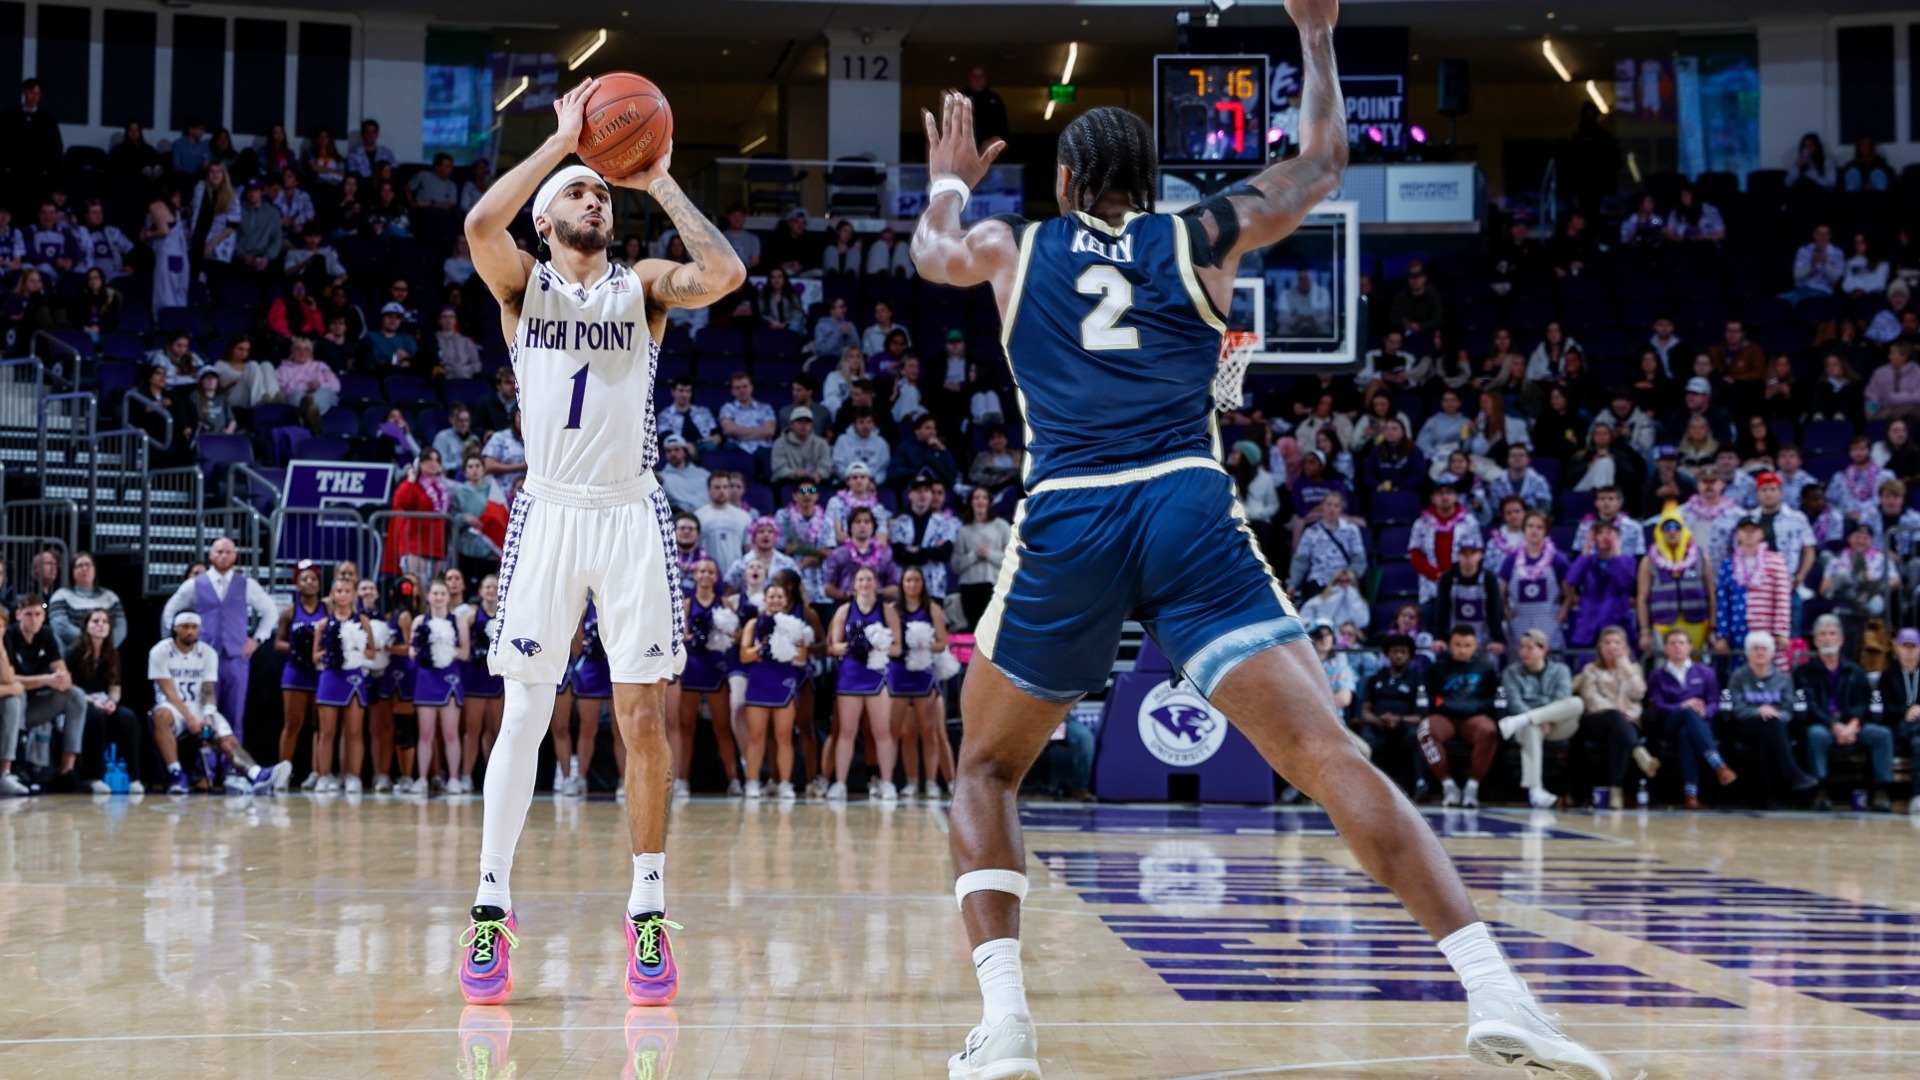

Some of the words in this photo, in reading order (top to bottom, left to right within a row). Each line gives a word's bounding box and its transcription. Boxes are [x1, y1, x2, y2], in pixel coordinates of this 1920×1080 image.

[843, 55, 889, 80] 112
[1188, 68, 1255, 98] 7:16
[1346, 96, 1404, 120] POINT
[584, 102, 643, 154] SPALDING
[1215, 101, 1245, 153] 7
[1071, 228, 1134, 262] KELLY
[1076, 264, 1139, 350] 2
[525, 317, 568, 350] HIGH
[574, 320, 635, 351] POINT
[562, 361, 590, 430] 1
[316, 470, 367, 493] THE
[179, 682, 197, 702] 55
